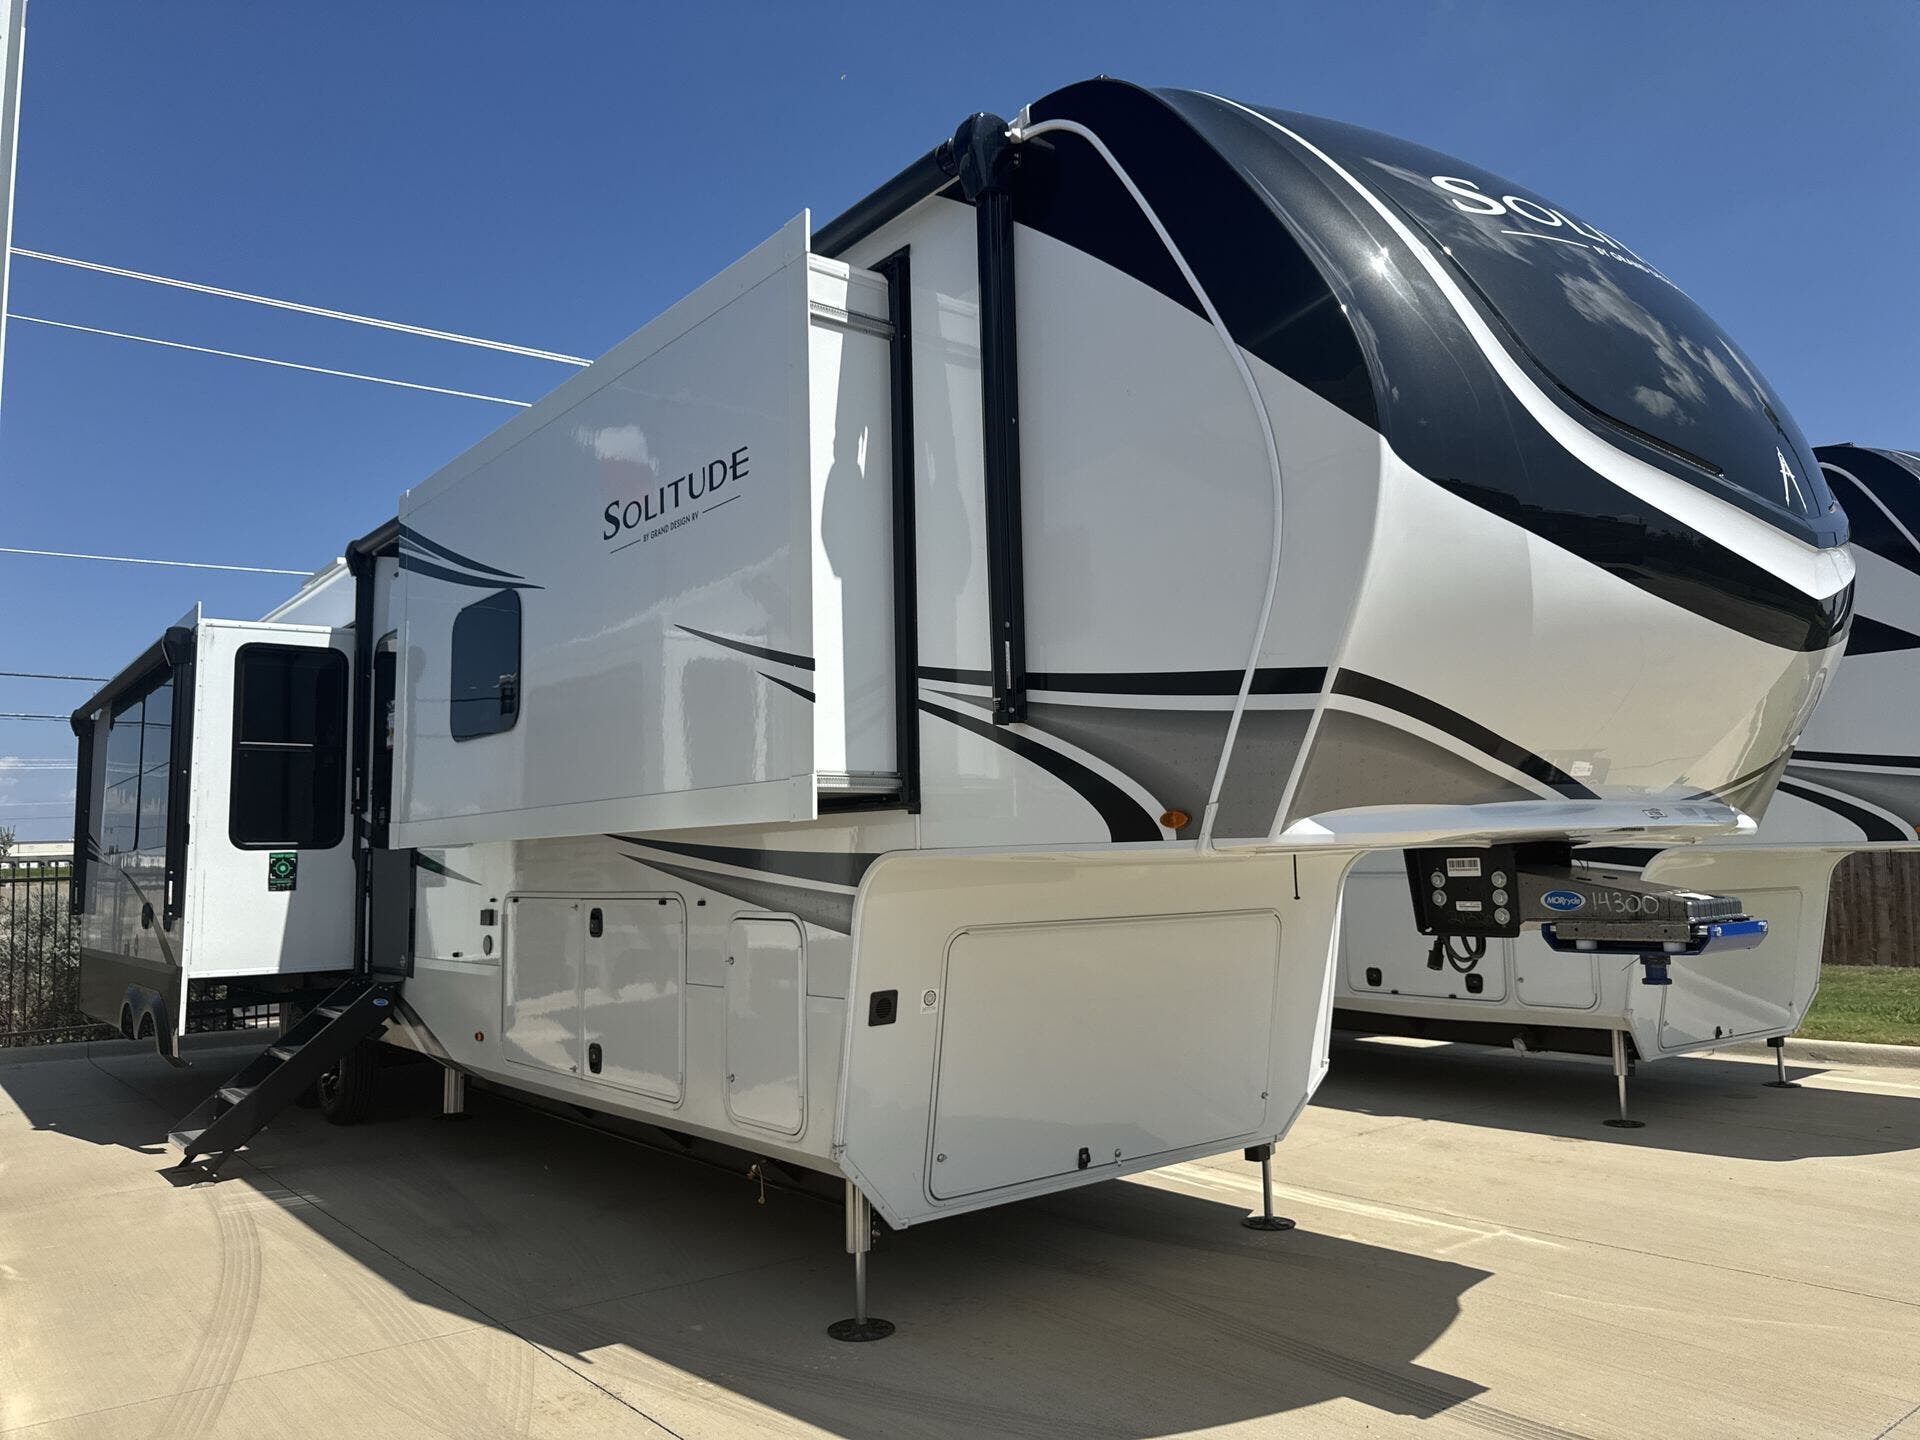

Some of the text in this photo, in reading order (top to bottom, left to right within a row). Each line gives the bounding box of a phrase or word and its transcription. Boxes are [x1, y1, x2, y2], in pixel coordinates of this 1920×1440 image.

[603, 446, 750, 541] SOLITUDE
[650, 524, 669, 539] GRAND
[670, 514, 691, 531] DESIGN
[1592, 891, 1660, 914] 14300
